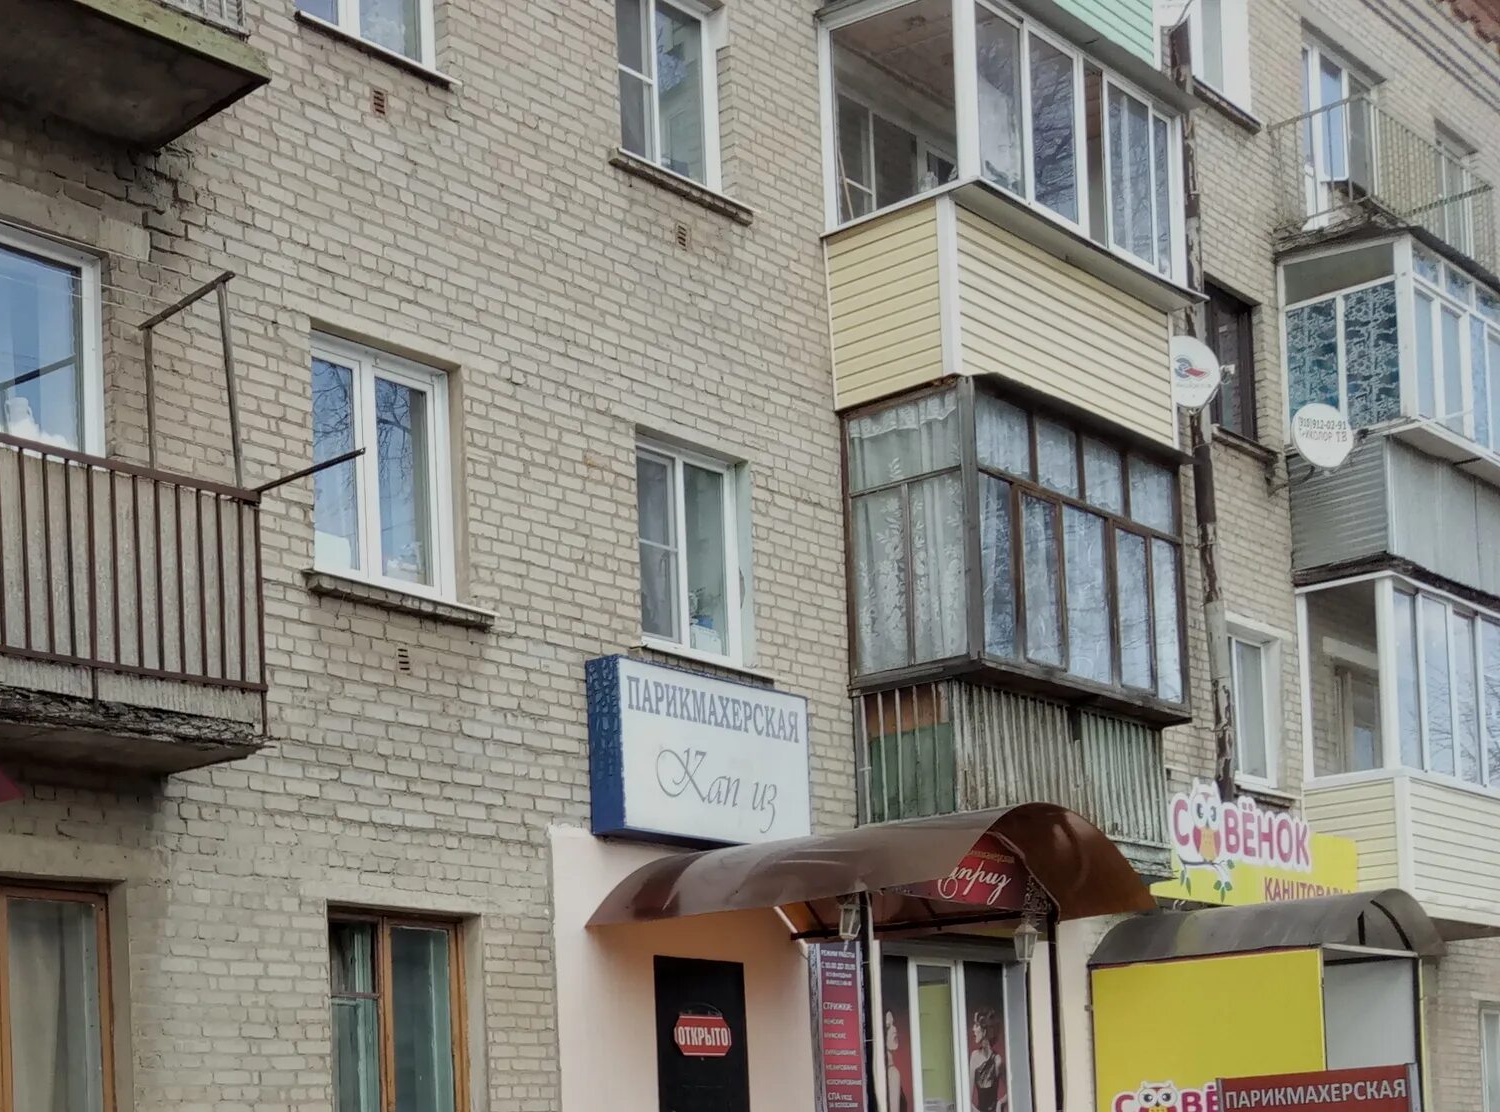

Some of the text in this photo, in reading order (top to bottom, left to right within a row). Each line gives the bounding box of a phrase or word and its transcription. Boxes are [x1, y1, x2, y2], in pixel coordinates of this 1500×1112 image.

[626, 675, 800, 744] ПАРИКМАХЕРСКАЯ
[677, 1026, 729, 1046] ОТКРЫТО
[1225, 1078, 1407, 1109] ПАРИКМАХЕРСКАЯ
